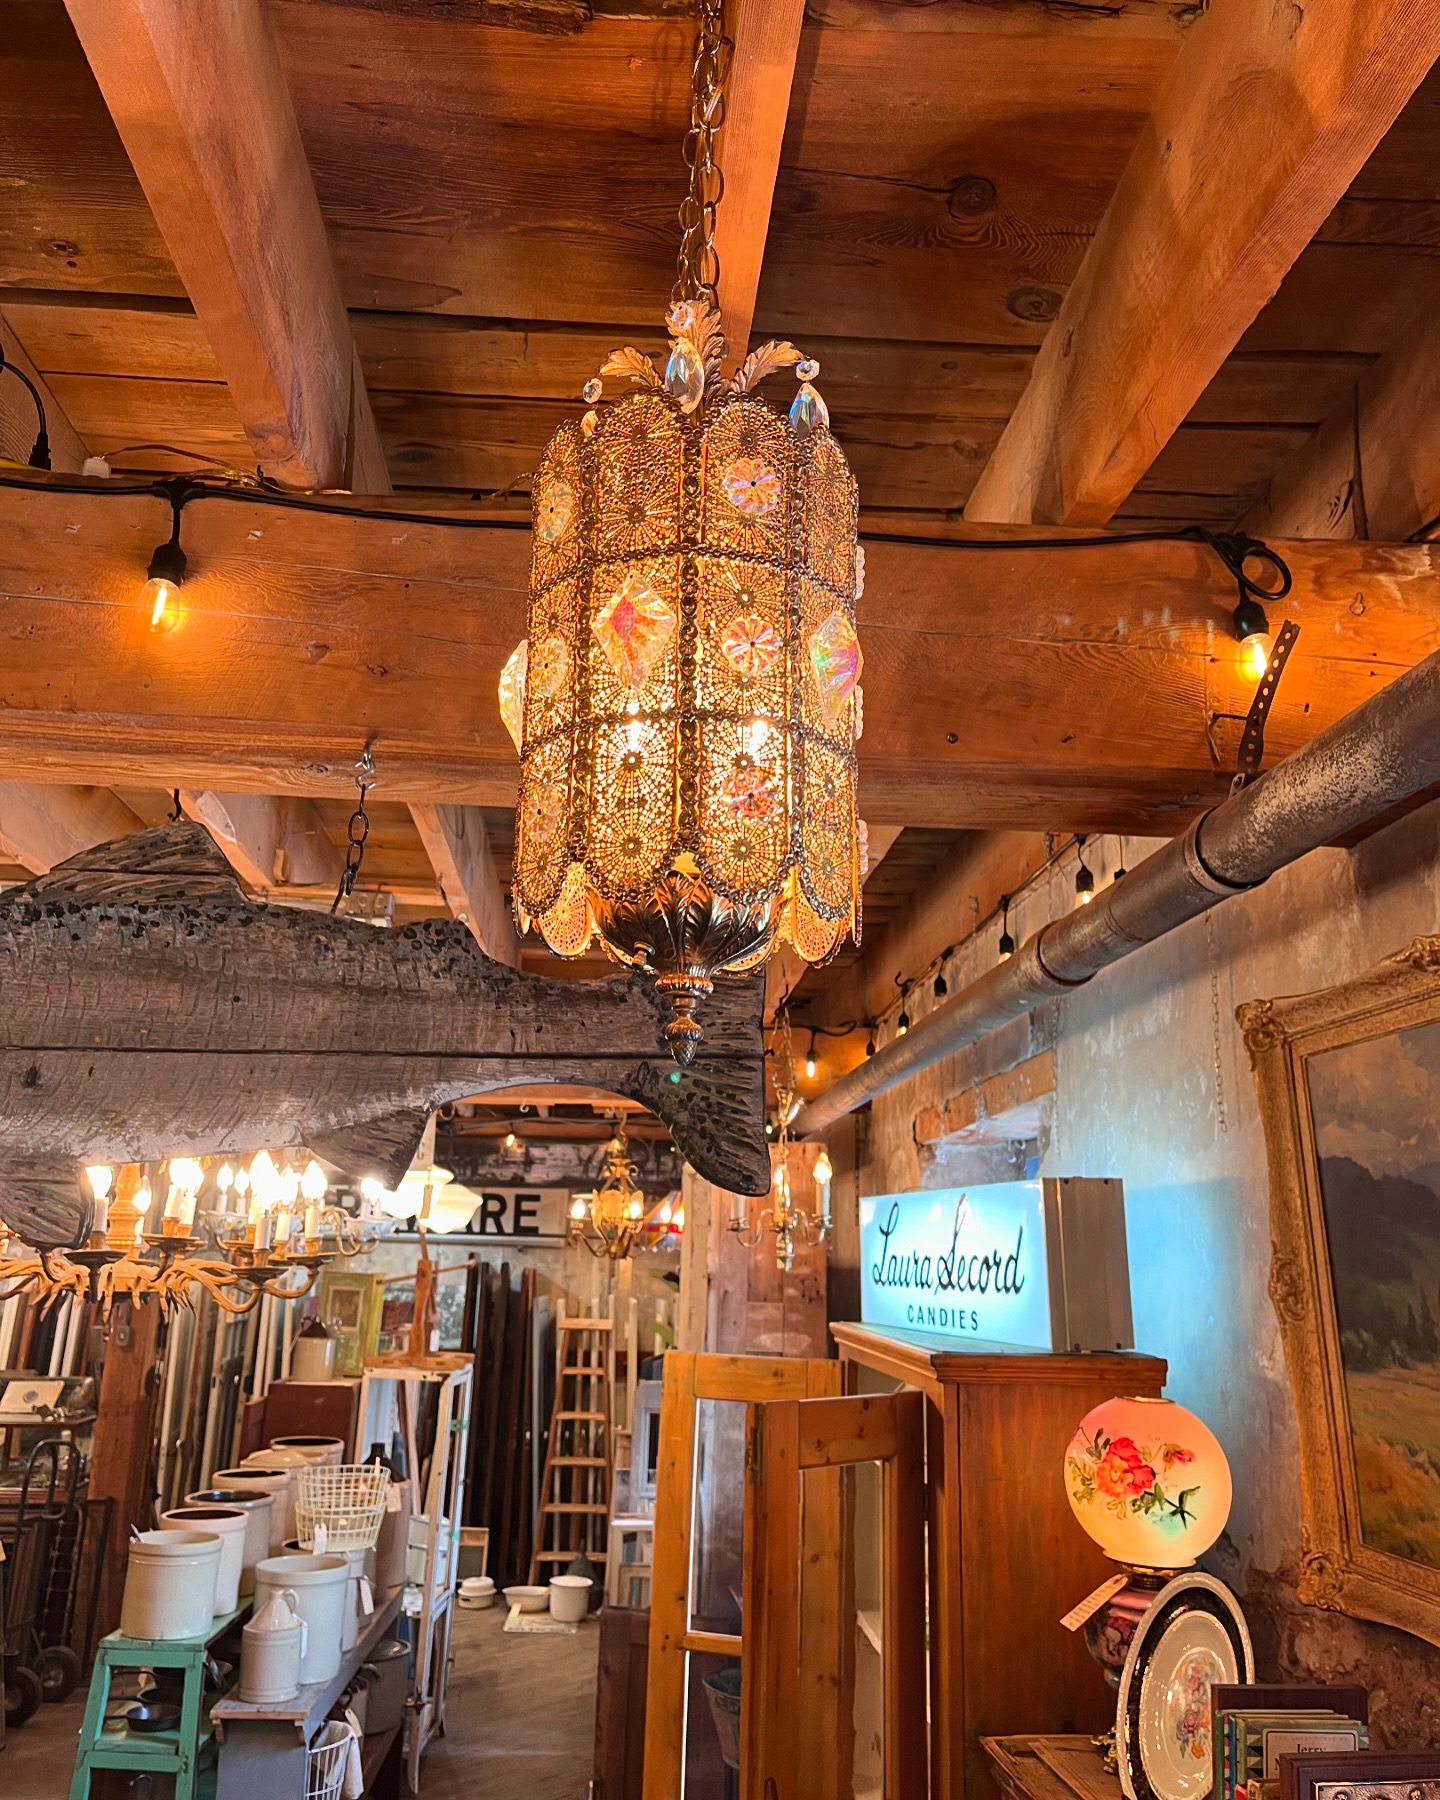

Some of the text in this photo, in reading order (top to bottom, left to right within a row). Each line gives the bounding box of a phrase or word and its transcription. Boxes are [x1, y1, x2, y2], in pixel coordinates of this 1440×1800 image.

[872, 1193, 1025, 1296] Laura Secord
[907, 1304, 979, 1331] CANDIES
